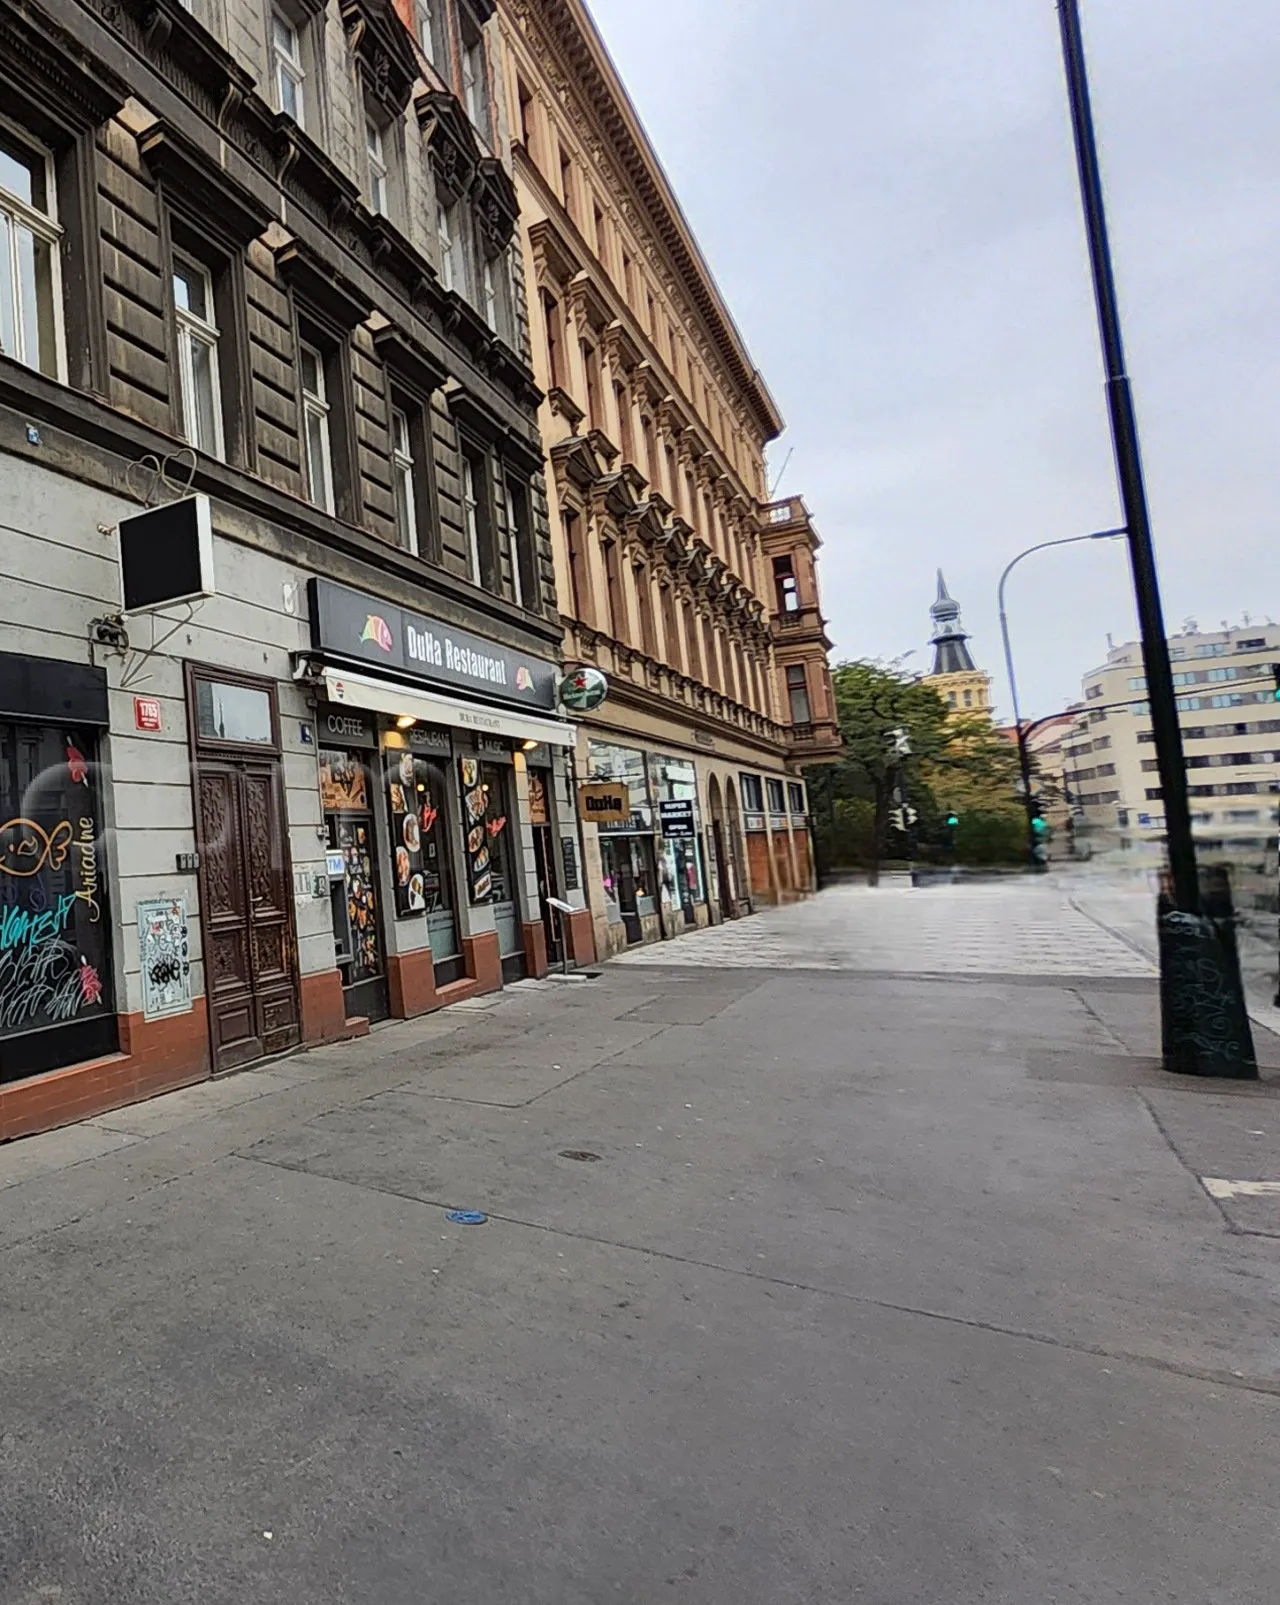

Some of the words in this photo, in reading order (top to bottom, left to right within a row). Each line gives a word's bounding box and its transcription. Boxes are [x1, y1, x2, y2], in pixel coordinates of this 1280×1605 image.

[406, 624, 443, 665] DuHa
[445, 638, 507, 685] Restaurant
[327, 714, 364, 737] COFFEE
[74, 816, 101, 922] Ariadne
